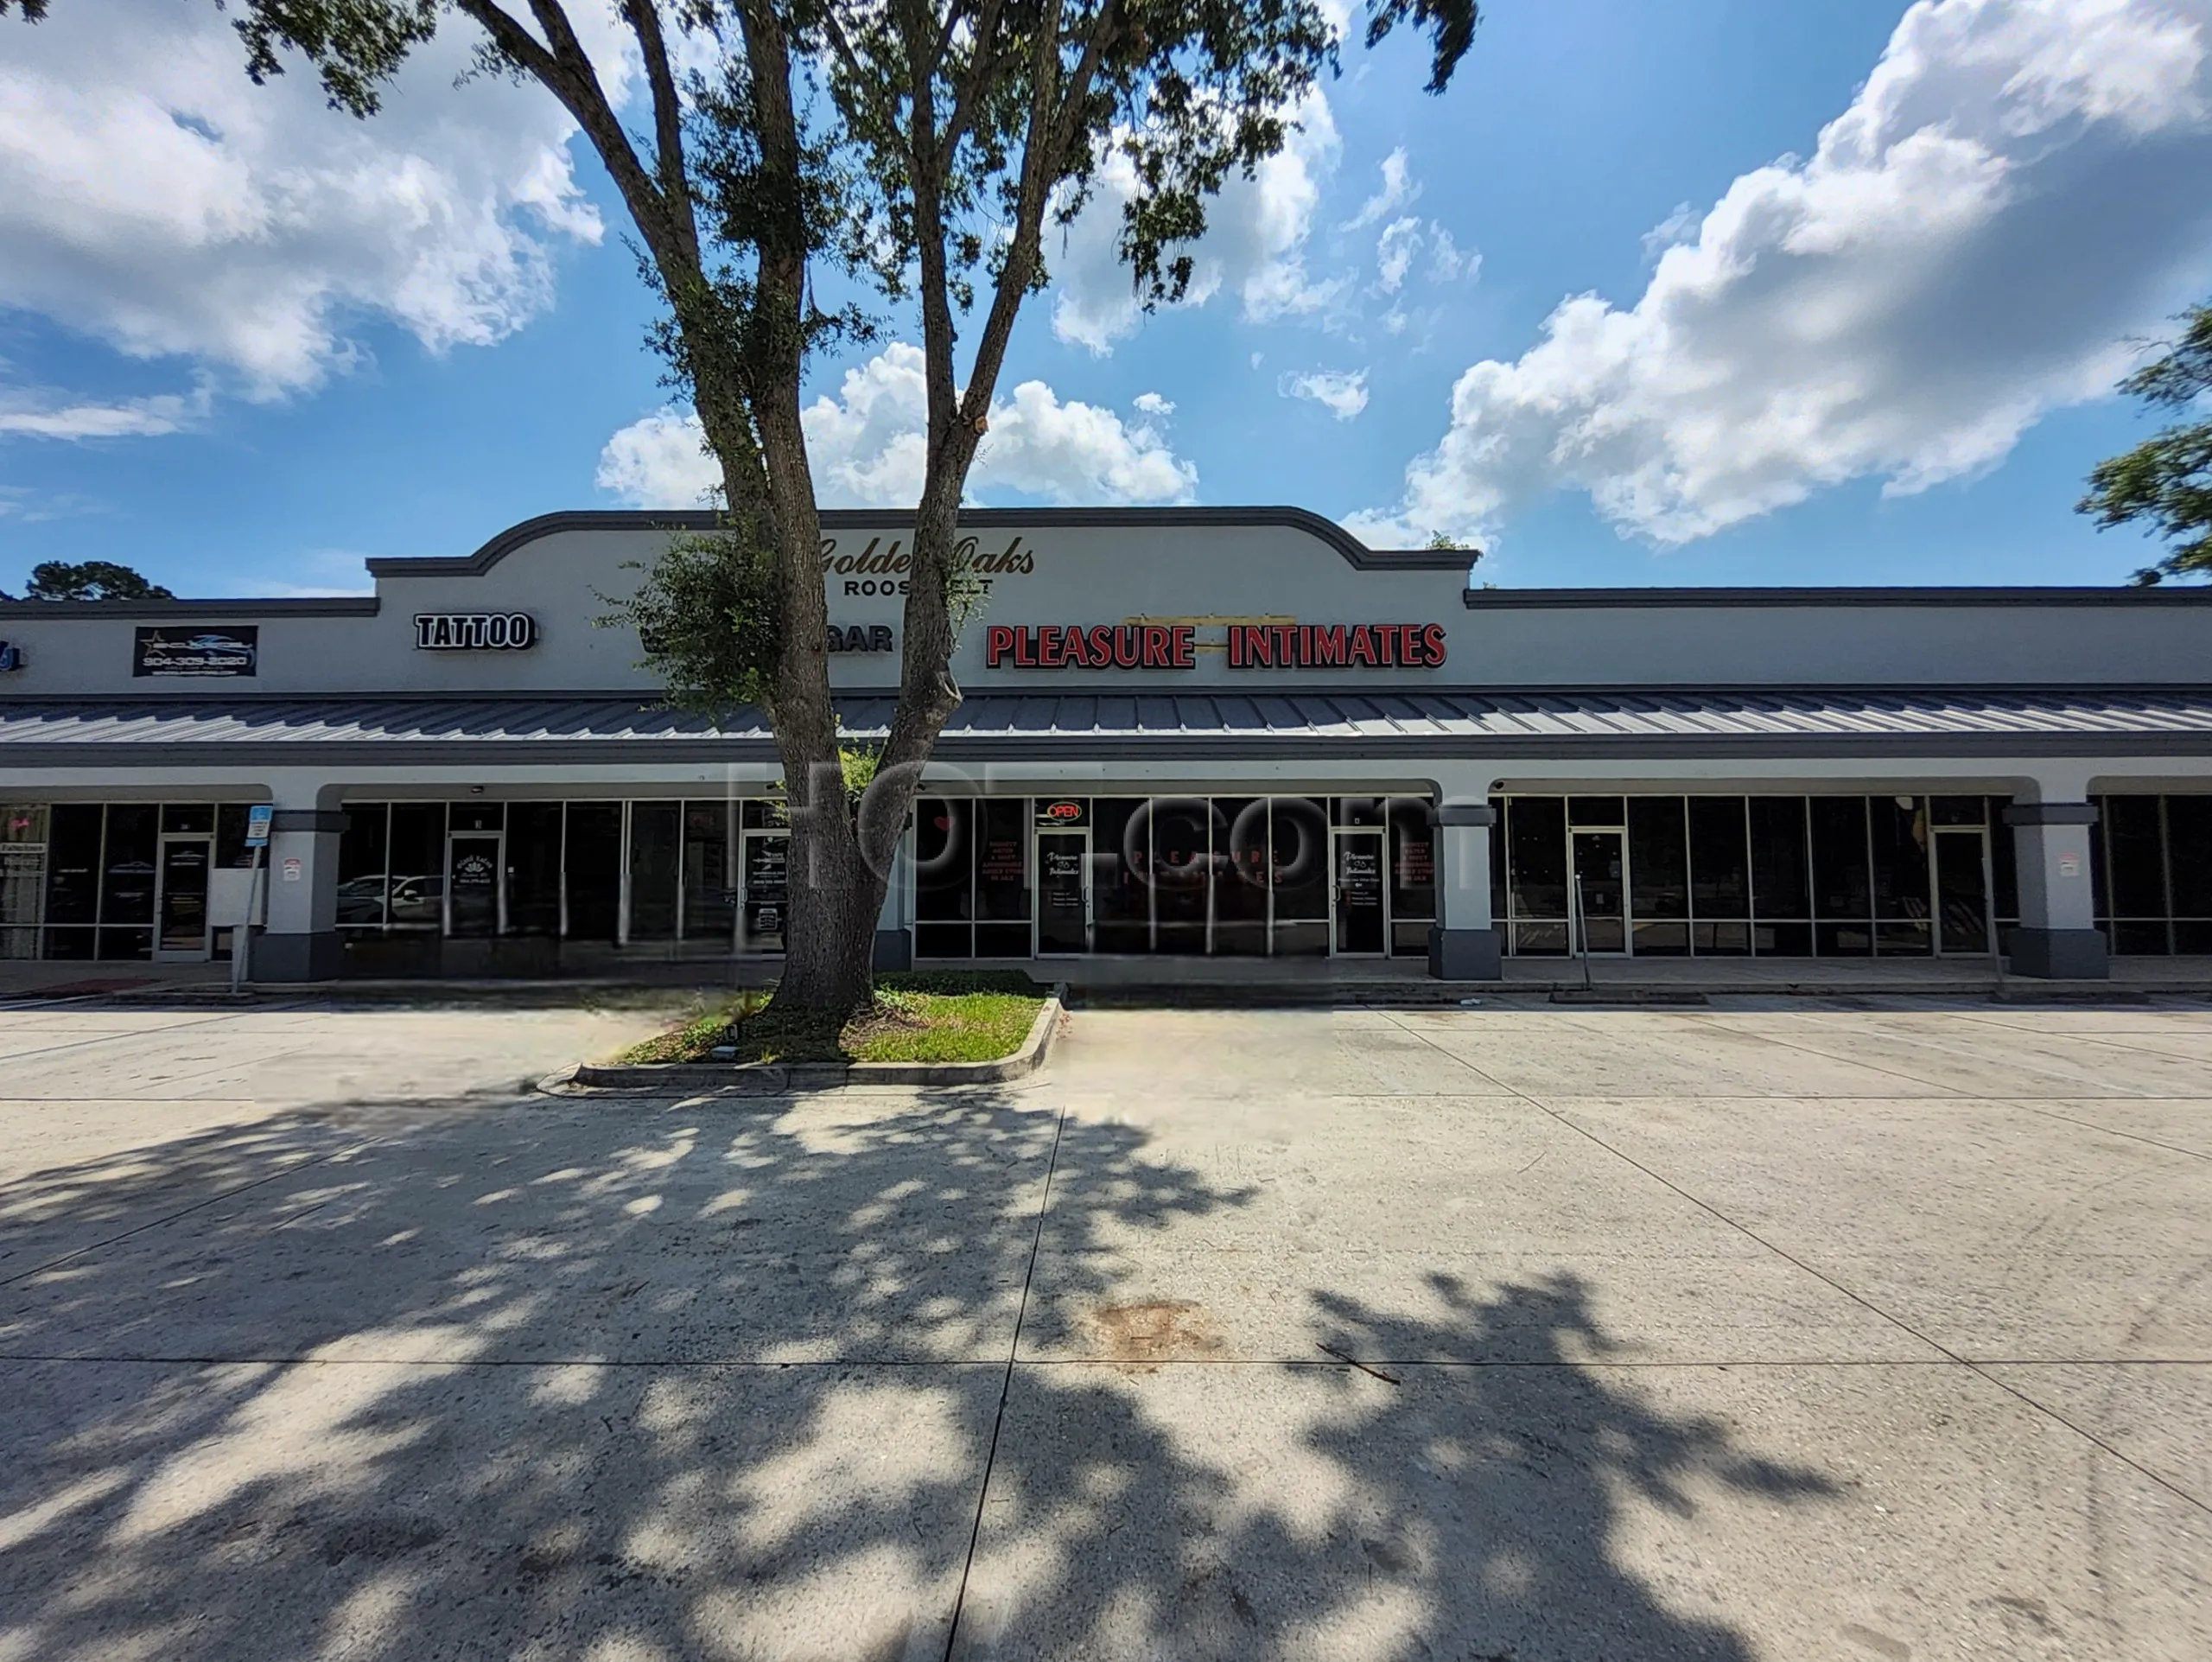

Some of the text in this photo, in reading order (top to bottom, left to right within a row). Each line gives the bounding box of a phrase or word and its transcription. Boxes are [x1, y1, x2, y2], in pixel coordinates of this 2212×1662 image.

[820, 536, 1034, 576] Golde Oaks
[415, 613, 531, 649] TATTOO
[987, 623, 1446, 669] PLEASURE INTIMATES
[1049, 805, 1079, 817] OPEN
